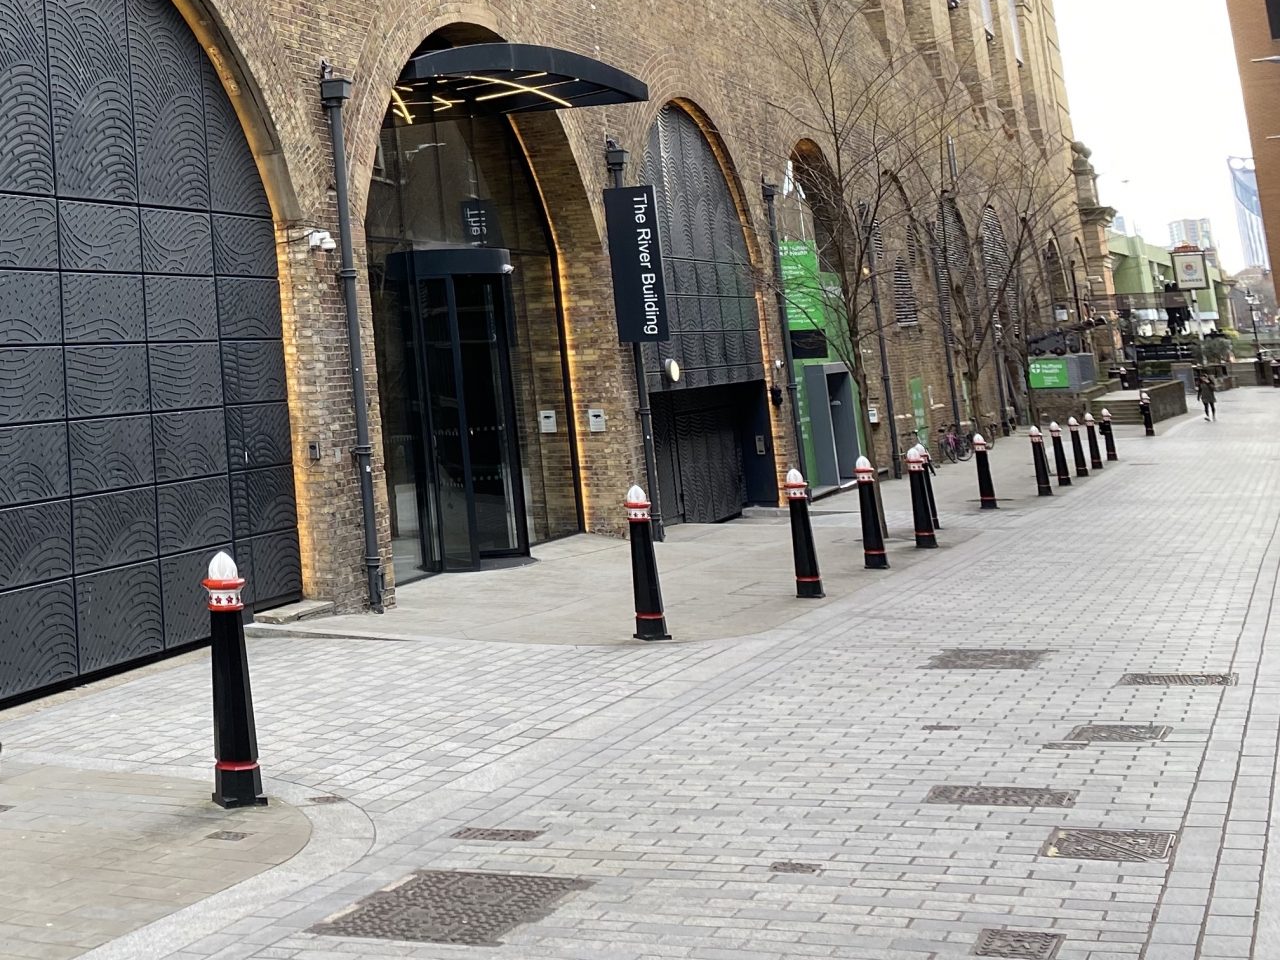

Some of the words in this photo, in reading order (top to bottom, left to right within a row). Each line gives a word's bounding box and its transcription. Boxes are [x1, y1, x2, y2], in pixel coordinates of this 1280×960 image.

[632, 193, 648, 223] The
[636, 228, 652, 268] River
[641, 274, 659, 336] Building
